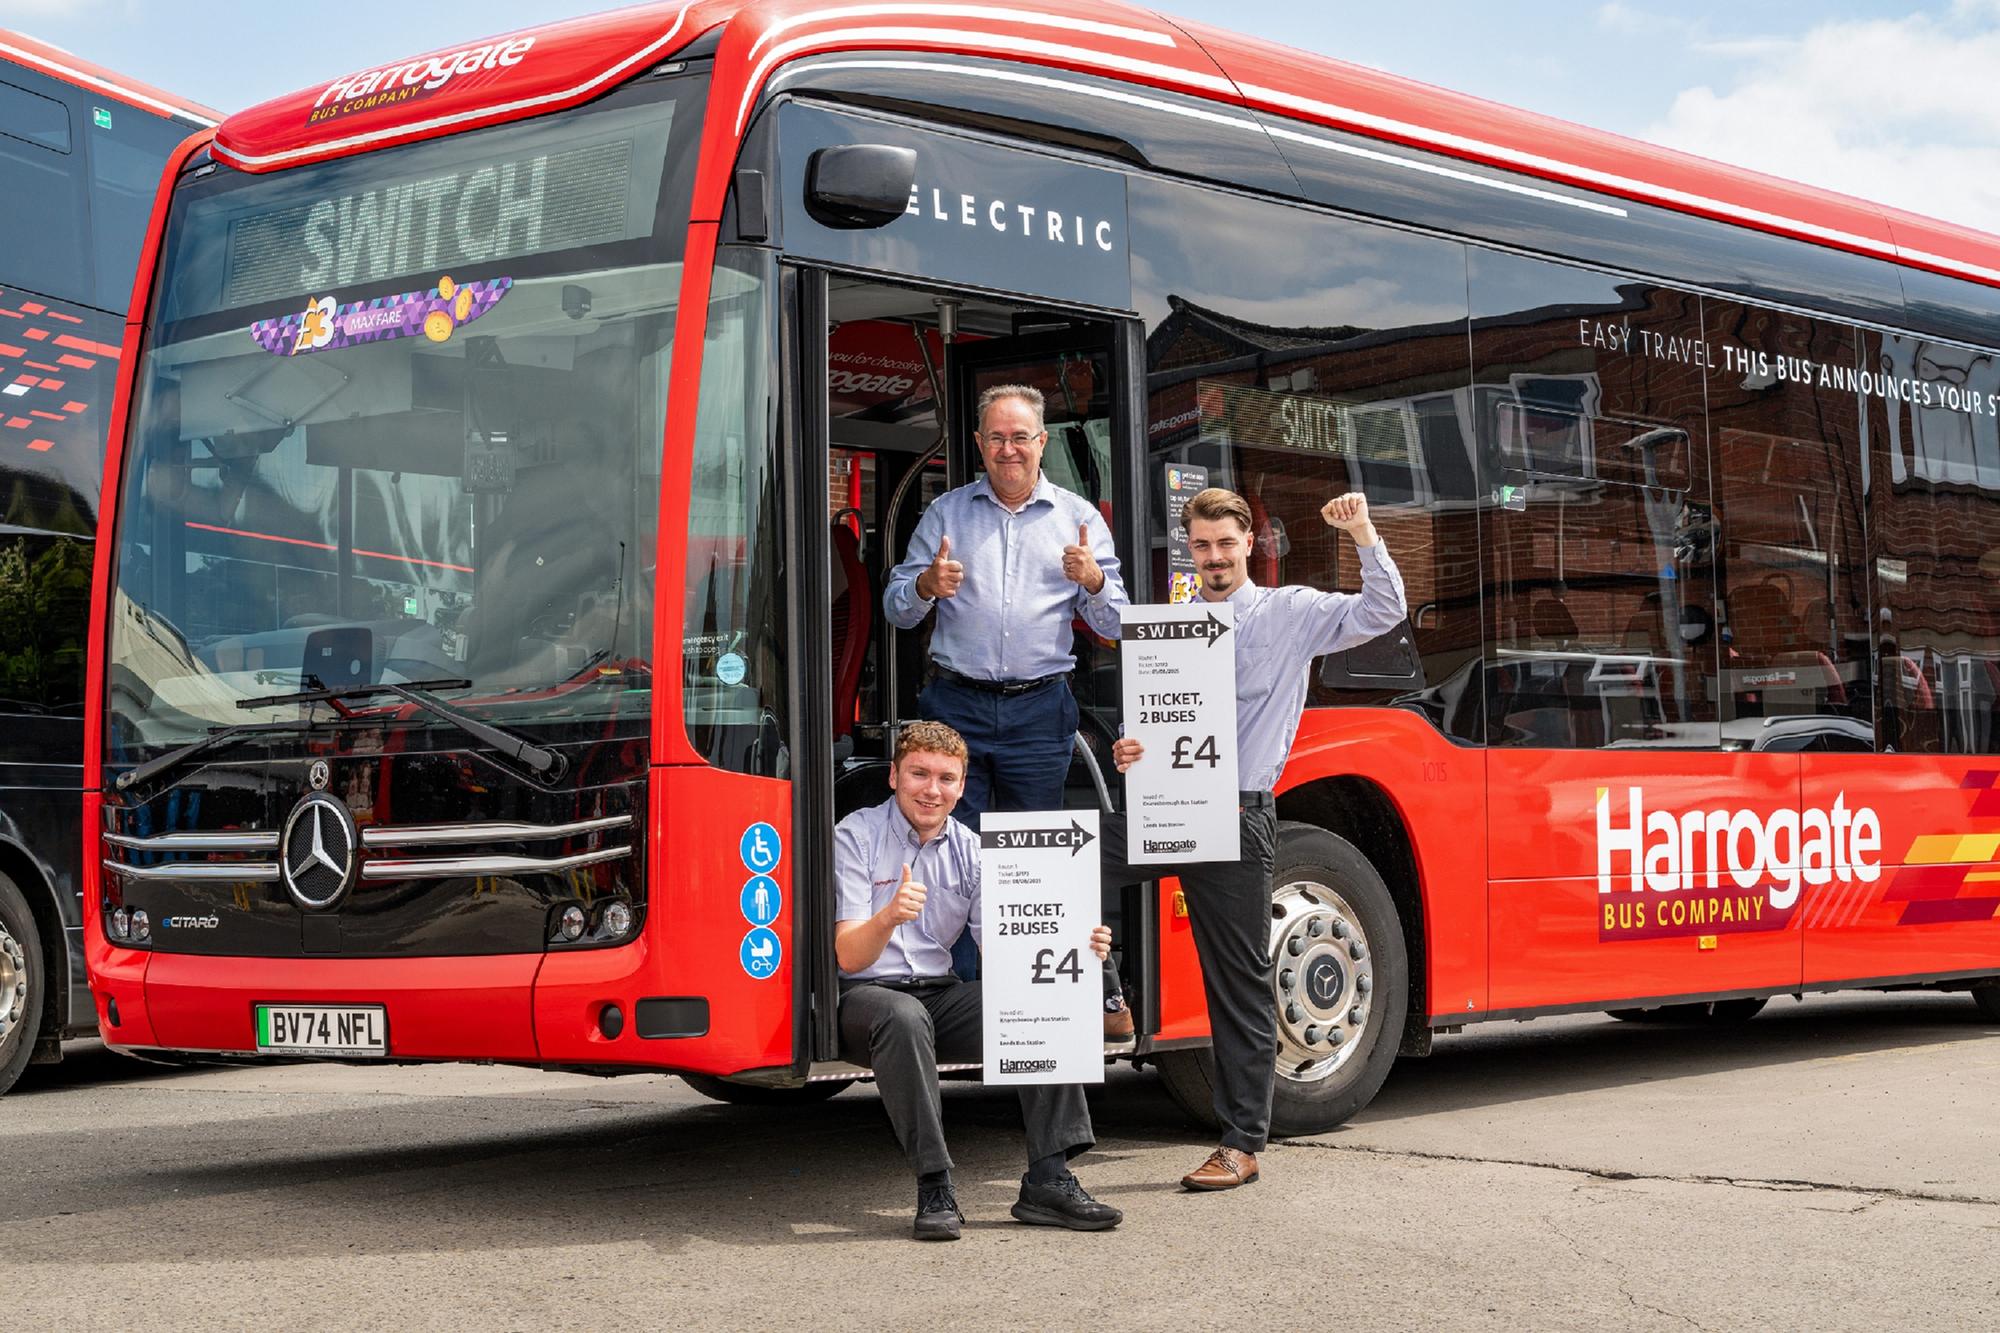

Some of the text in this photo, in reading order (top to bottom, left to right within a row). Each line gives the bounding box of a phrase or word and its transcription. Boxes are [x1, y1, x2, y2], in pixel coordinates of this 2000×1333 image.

[313, 36, 537, 107] Harrogate
[310, 85, 422, 122] BUS COMPANY
[300, 156, 548, 291] SWITCH
[905, 183, 1113, 251] ELECTRIC
[296, 295, 402, 351] £3 MAX FARE
[1580, 319, 2000, 417] EASY TRAVEL THIS BUS ANNOUNCES YOUR S
[1280, 397, 1351, 453] SWITCH
[1136, 623, 1219, 639] SWITCH
[1139, 692, 1203, 707] 1 TICKET,
[1140, 710, 1196, 724] 2 BUSES
[1171, 735, 1221, 769] £4
[1422, 761, 1448, 782] 1015
[996, 831, 1084, 847] SWITCH
[1143, 839, 1197, 853] Harrogate
[1596, 787, 1882, 909] Harrogate
[162, 916, 219, 929] eCITARO
[999, 903, 1065, 918] 1 TICKET,
[1604, 895, 1765, 930] BUS COMPANY
[999, 921, 1059, 936] 2 BUSES
[1031, 948, 1084, 984] £4
[273, 1012, 382, 1045] BV74 NFL
[999, 1058, 1057, 1073] Harrogate
